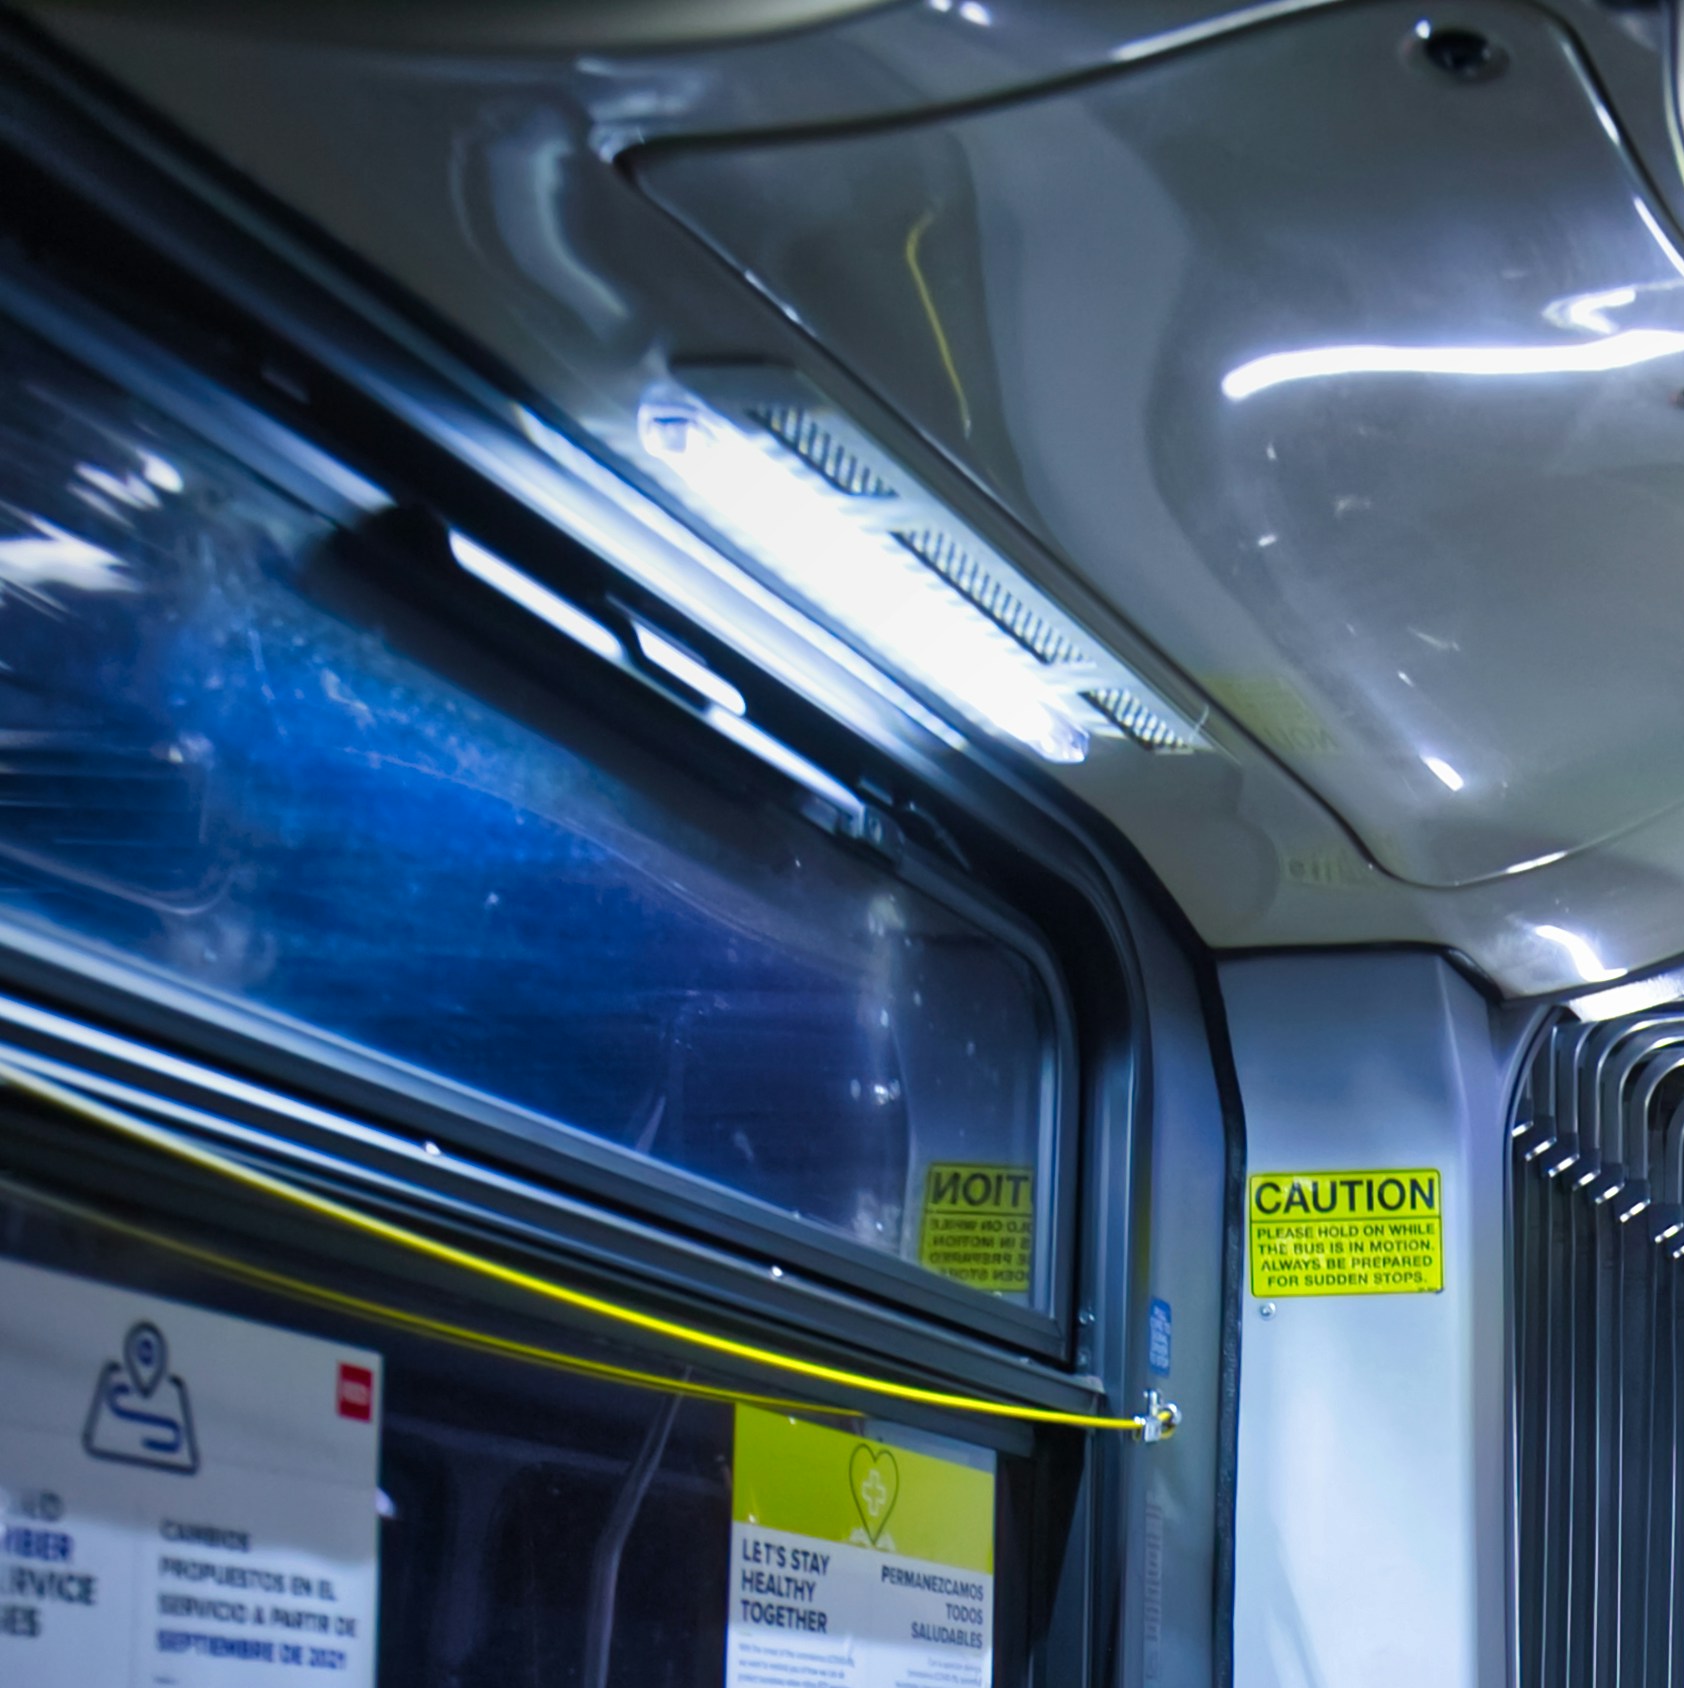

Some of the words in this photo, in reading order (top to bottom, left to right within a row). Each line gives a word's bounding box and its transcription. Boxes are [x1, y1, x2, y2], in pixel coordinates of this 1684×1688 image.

[1255, 1178, 1435, 1214] CAUTION
[1257, 1226, 1313, 1239] PLEASE
[1317, 1225, 1359, 1238] HOLD
[1363, 1223, 1385, 1236] ON
[1389, 1222, 1435, 1236] WHILE
[1258, 1244, 1288, 1255] THE
[1293, 1242, 1325, 1254] BUS
[1330, 1241, 1344, 1254] IS
[1349, 1240, 1364, 1253] IN
[1261, 1257, 1321, 1272] ALWAYS
[1327, 1256, 1346, 1270] BE
[1351, 1255, 1433, 1269] PREPARED
[1268, 1274, 1299, 1287] FOR
[1304, 1272, 1368, 1286] SUDDEN
[741, 1537, 787, 1569] LET'S
[790, 1546, 831, 1577] STAY
[740, 1568, 818, 1603] HEALTHY
[881, 1564, 985, 1602] PERMANEZCAMOS
[740, 1599, 828, 1634] TOGETHER
[945, 1602, 984, 1626] TODOS
[910, 1621, 984, 1649] SALUDABLES
